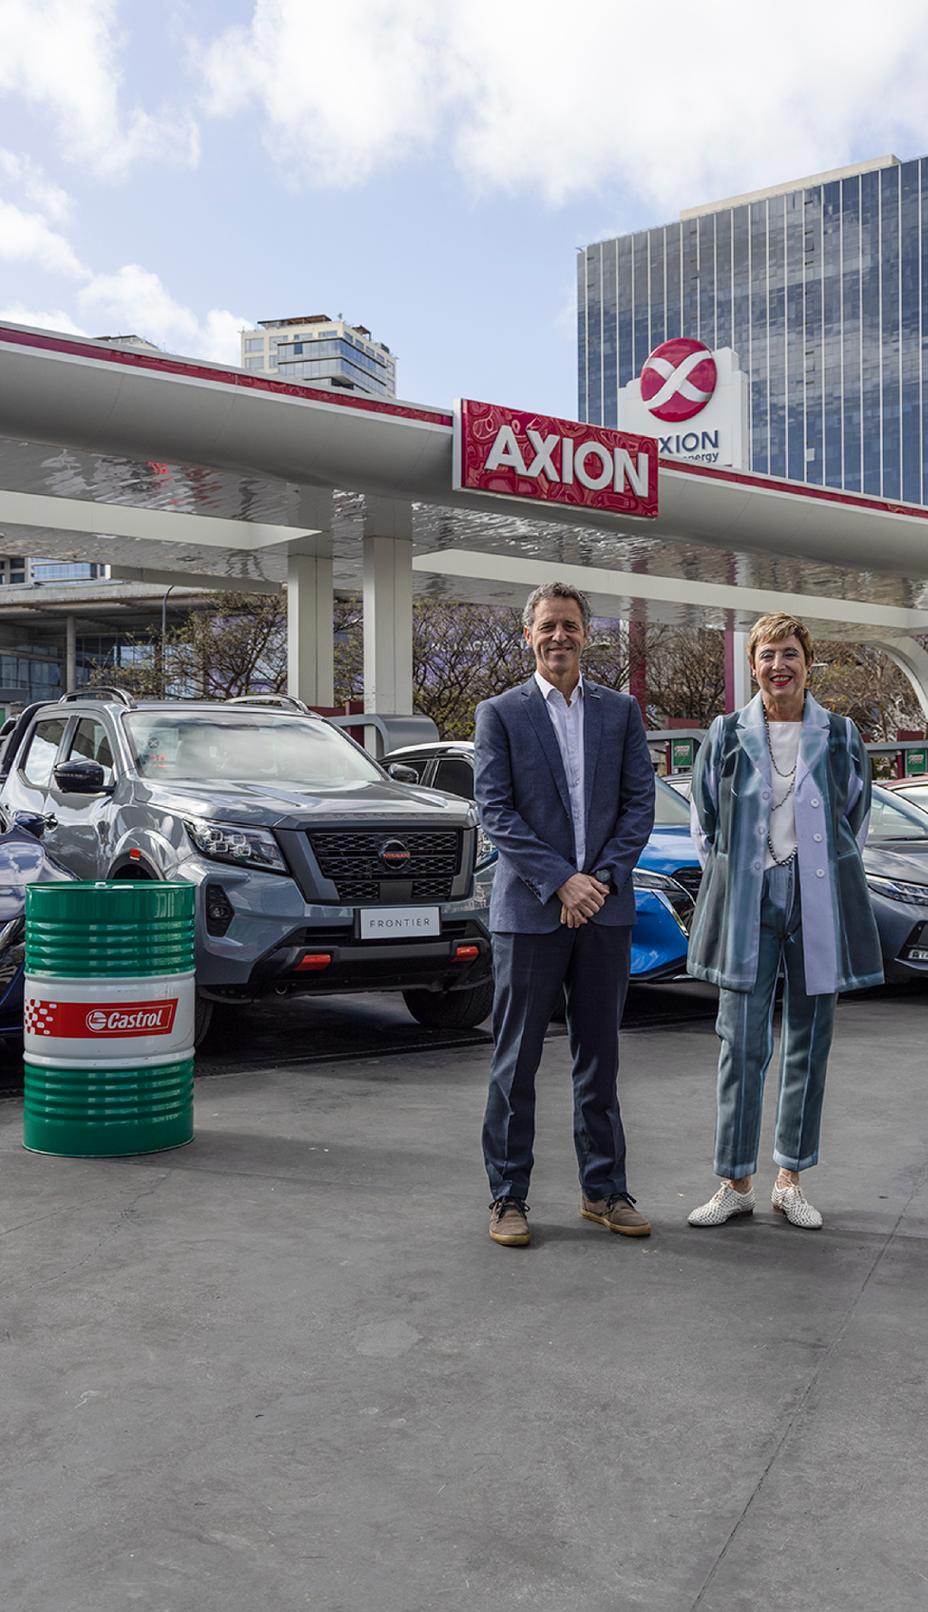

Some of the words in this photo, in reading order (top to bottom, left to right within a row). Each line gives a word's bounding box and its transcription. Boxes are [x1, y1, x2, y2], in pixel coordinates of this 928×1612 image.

[659, 430, 719, 454] XION
[484, 425, 649, 497] AXION
[683, 452, 719, 463] nergy
[369, 918, 430, 928] FRONTIER
[107, 1010, 163, 1029] Castrol
